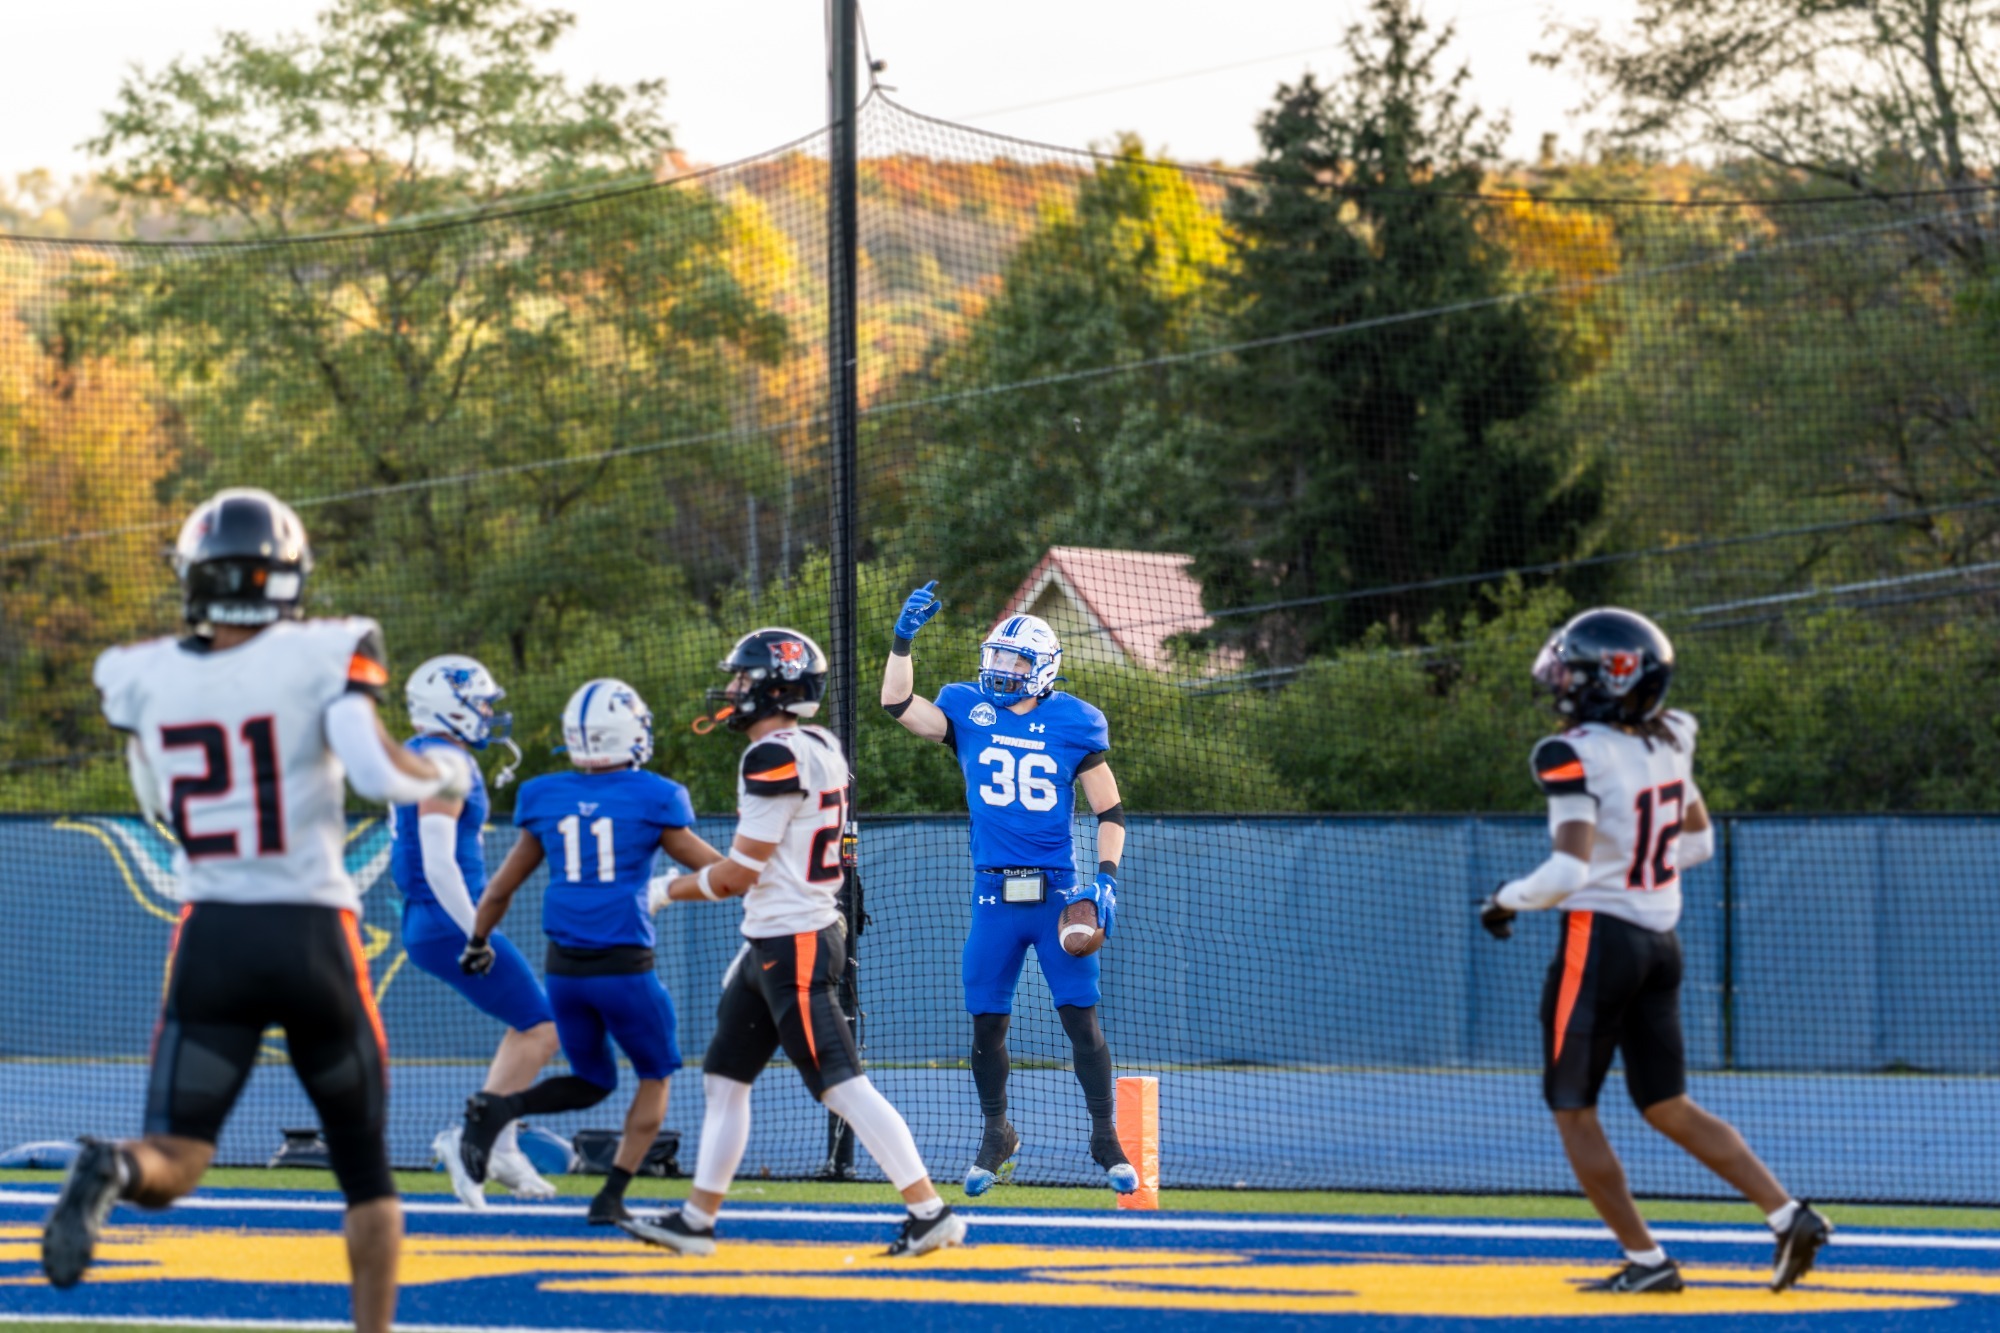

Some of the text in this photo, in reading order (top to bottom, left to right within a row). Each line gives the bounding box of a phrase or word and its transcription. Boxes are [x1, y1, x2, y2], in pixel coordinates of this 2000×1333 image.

[978, 746, 1058, 812] 36
[991, 733, 1046, 751] PIONEERS
[157, 713, 287, 864] 21
[557, 813, 616, 883] 11
[805, 784, 850, 884] 2
[1624, 777, 1685, 891] 12
